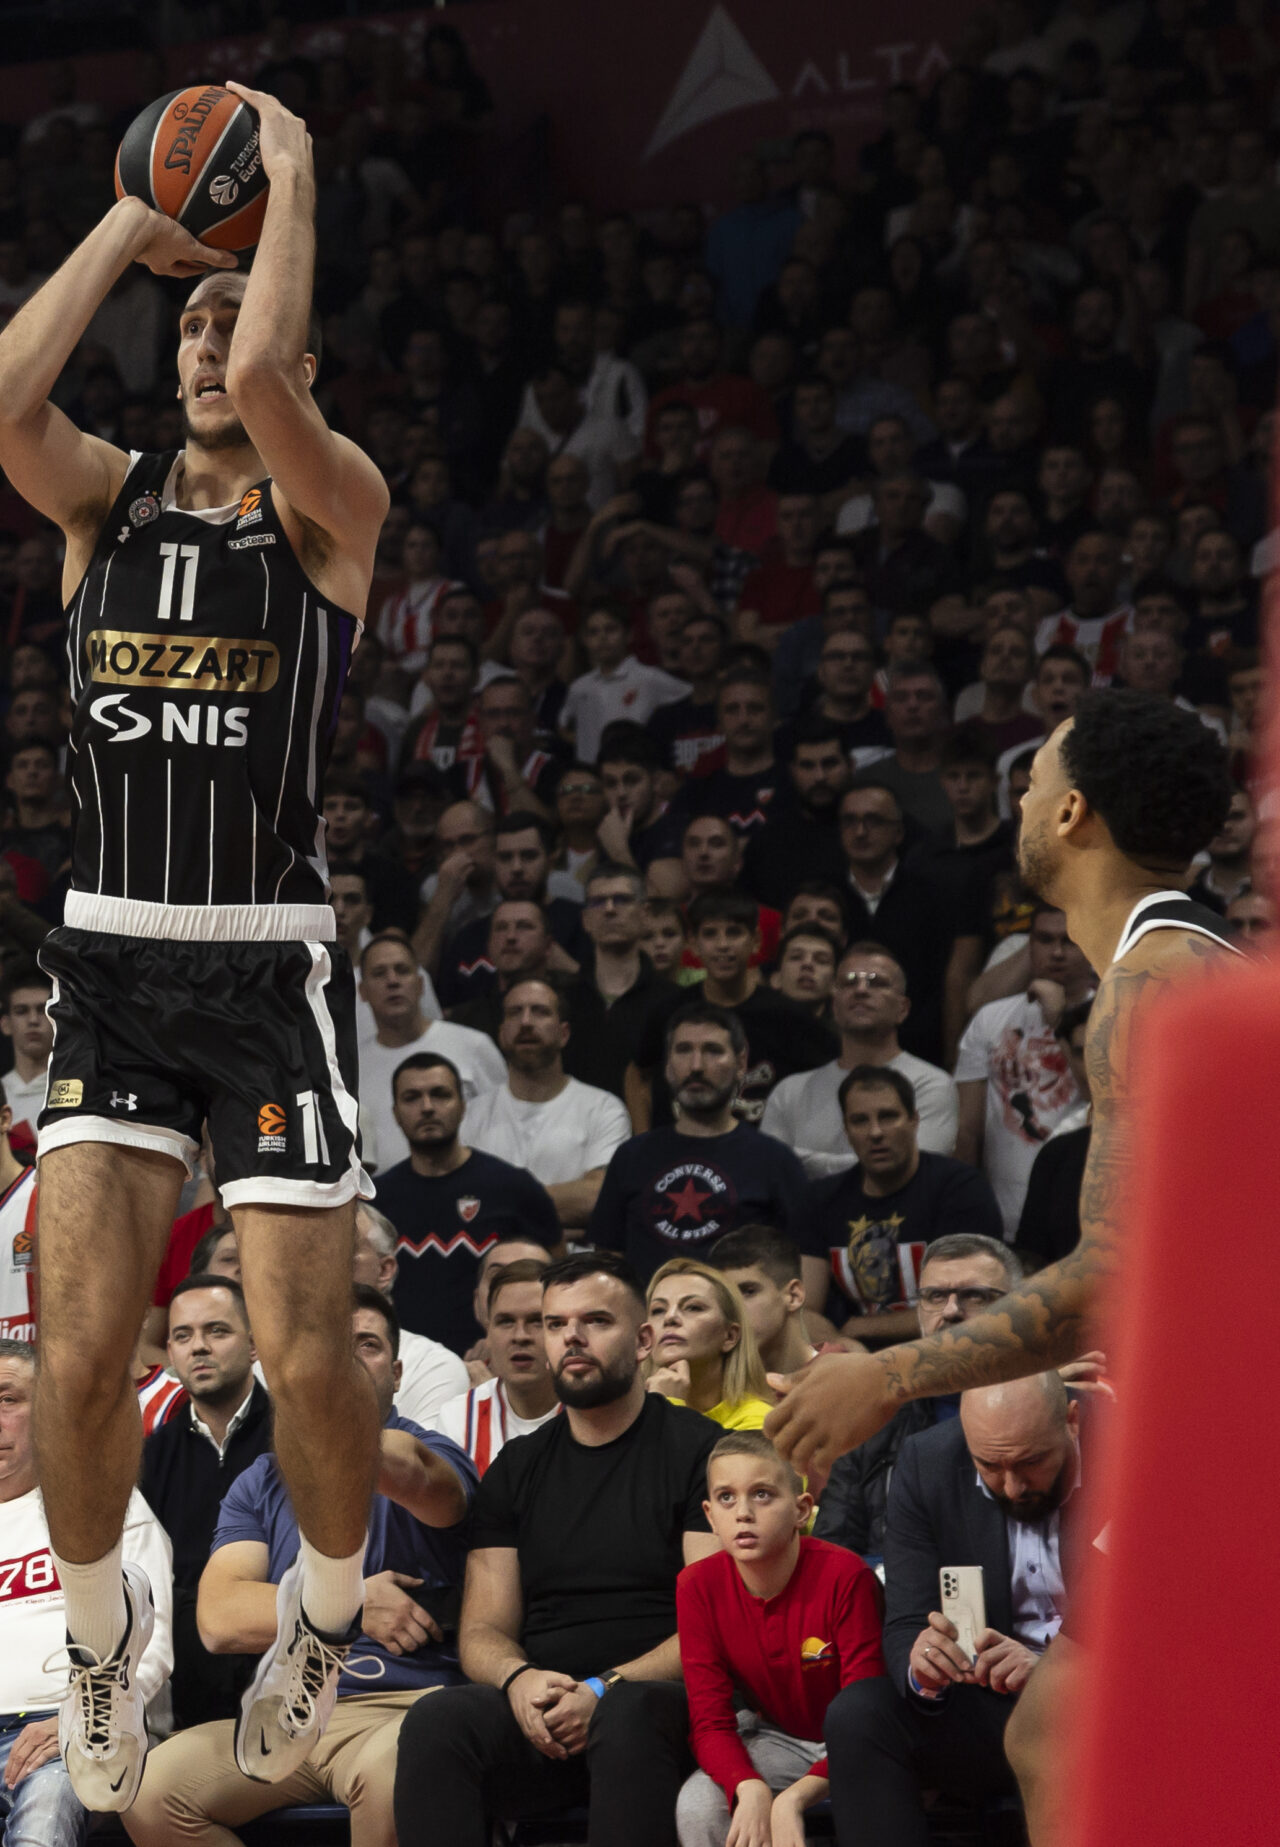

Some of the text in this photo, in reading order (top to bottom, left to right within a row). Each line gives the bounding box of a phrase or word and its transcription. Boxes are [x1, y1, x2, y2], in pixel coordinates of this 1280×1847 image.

[157, 542, 200, 621] 11
[91, 639, 274, 683] MOZZART
[162, 702, 250, 747] NIS
[654, 1163, 727, 1194] CONVERSE
